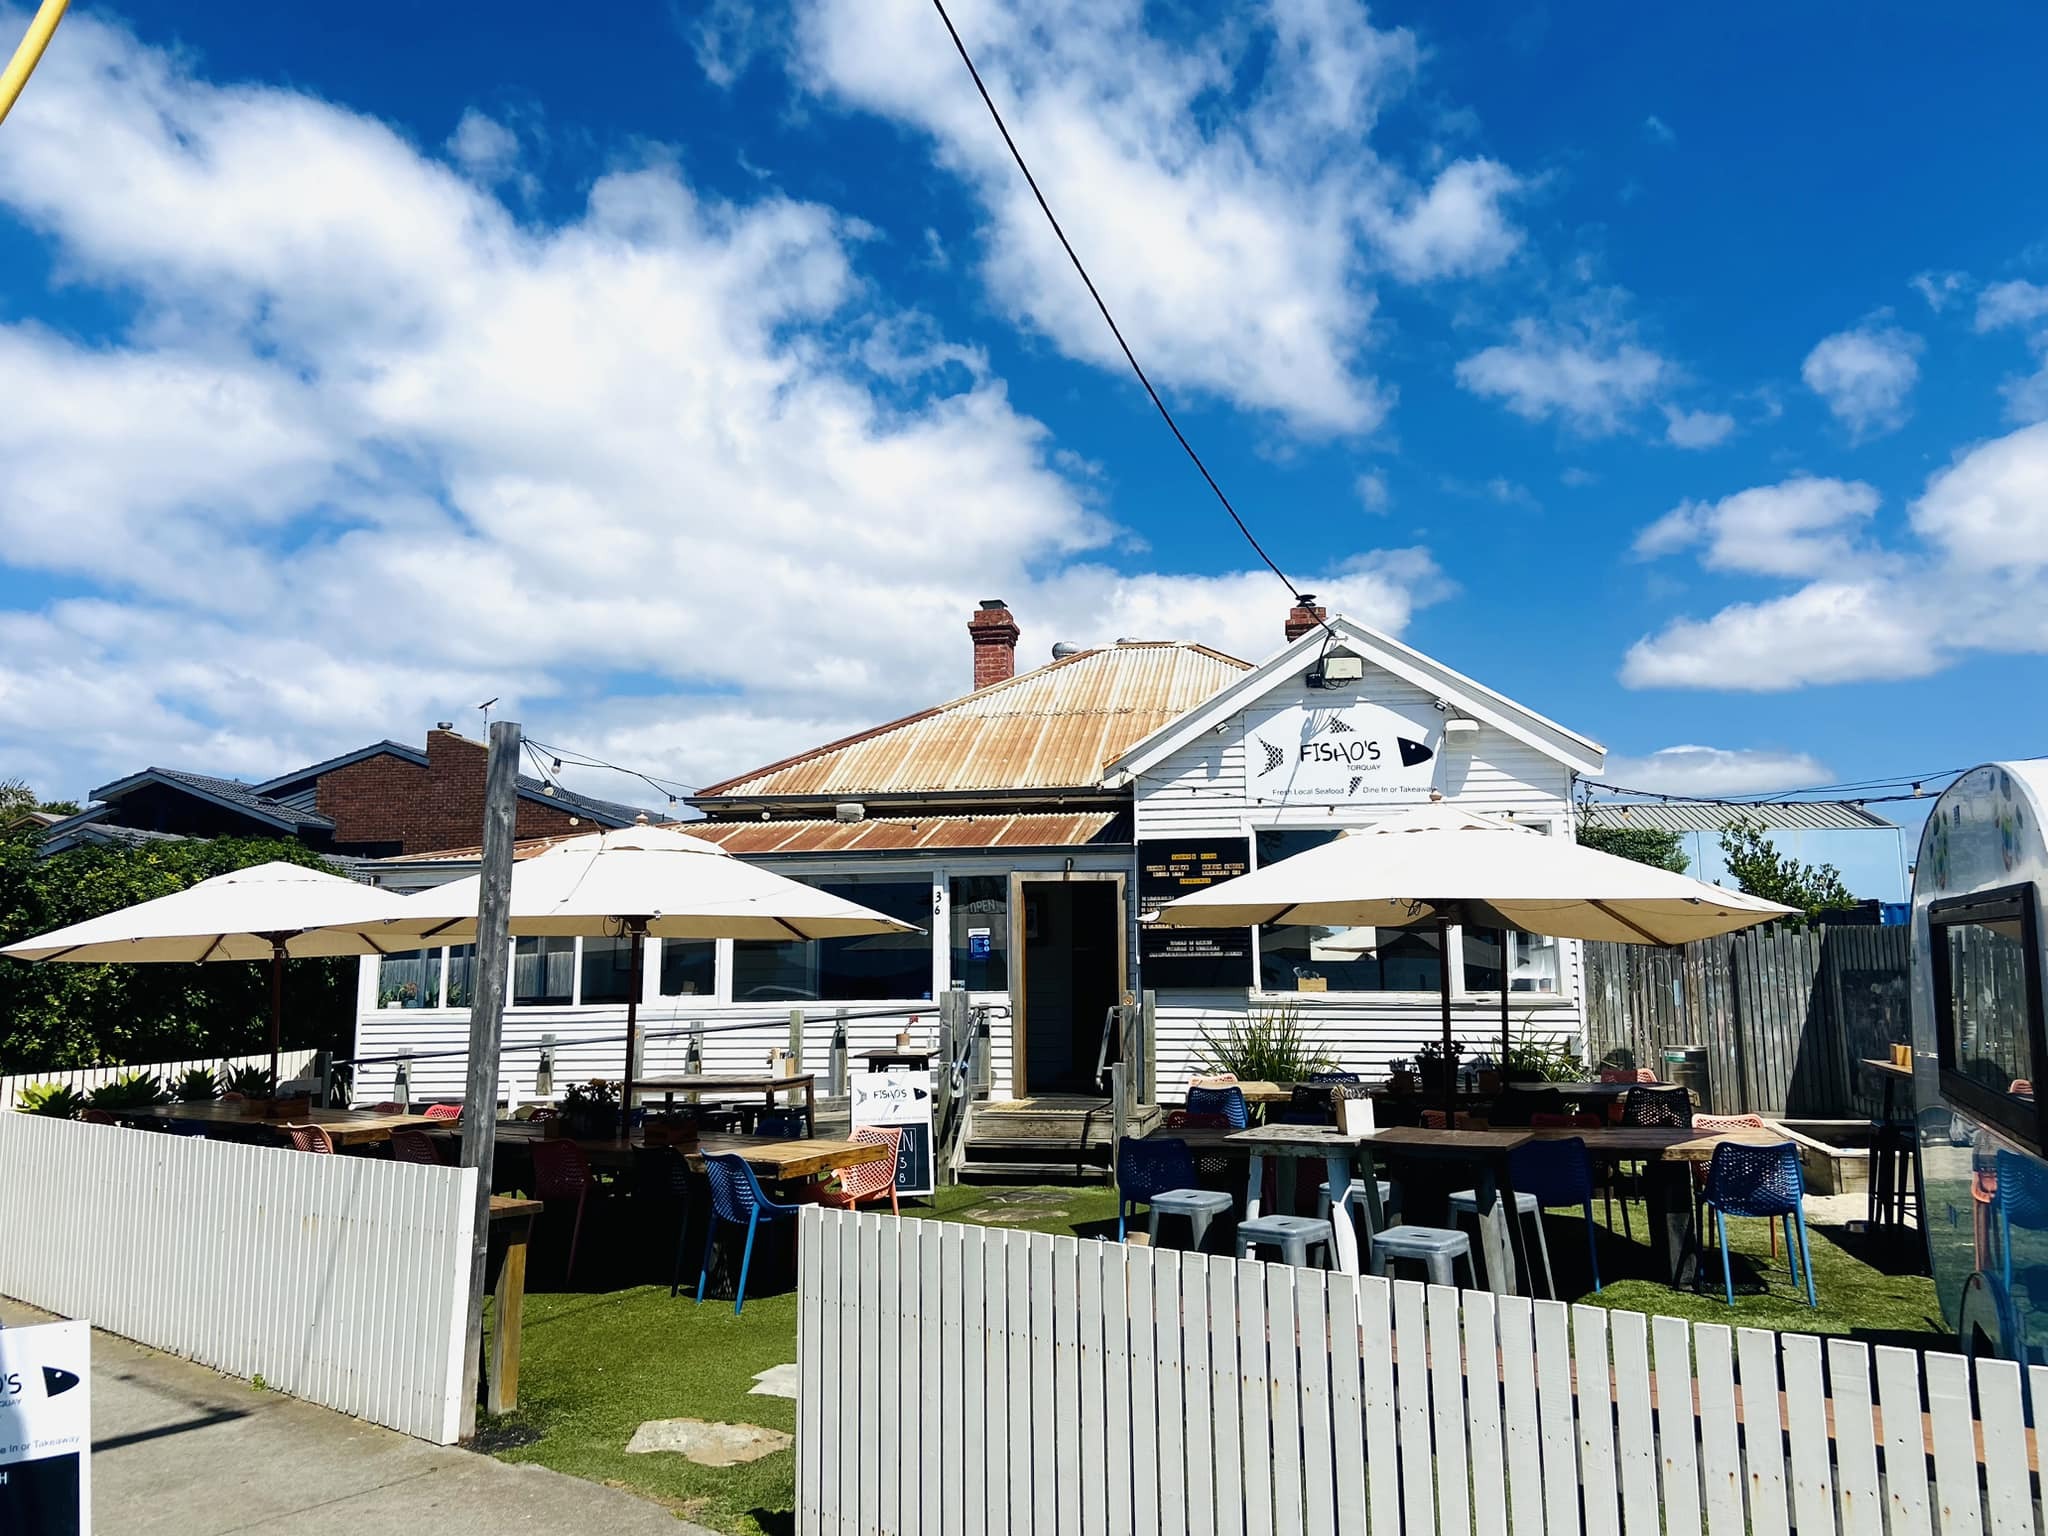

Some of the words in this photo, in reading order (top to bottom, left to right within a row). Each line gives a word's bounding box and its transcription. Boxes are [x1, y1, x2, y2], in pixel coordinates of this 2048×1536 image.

[1300, 741, 1381, 764] FISHO'S
[1315, 787, 1344, 795] Seafood
[1362, 786, 1380, 794] Dine
[969, 899, 996, 913] OPEN
[9, 1443, 19, 1453] In
[20, 1442, 31, 1451] or
[34, 1436, 80, 1449] Takeaway
